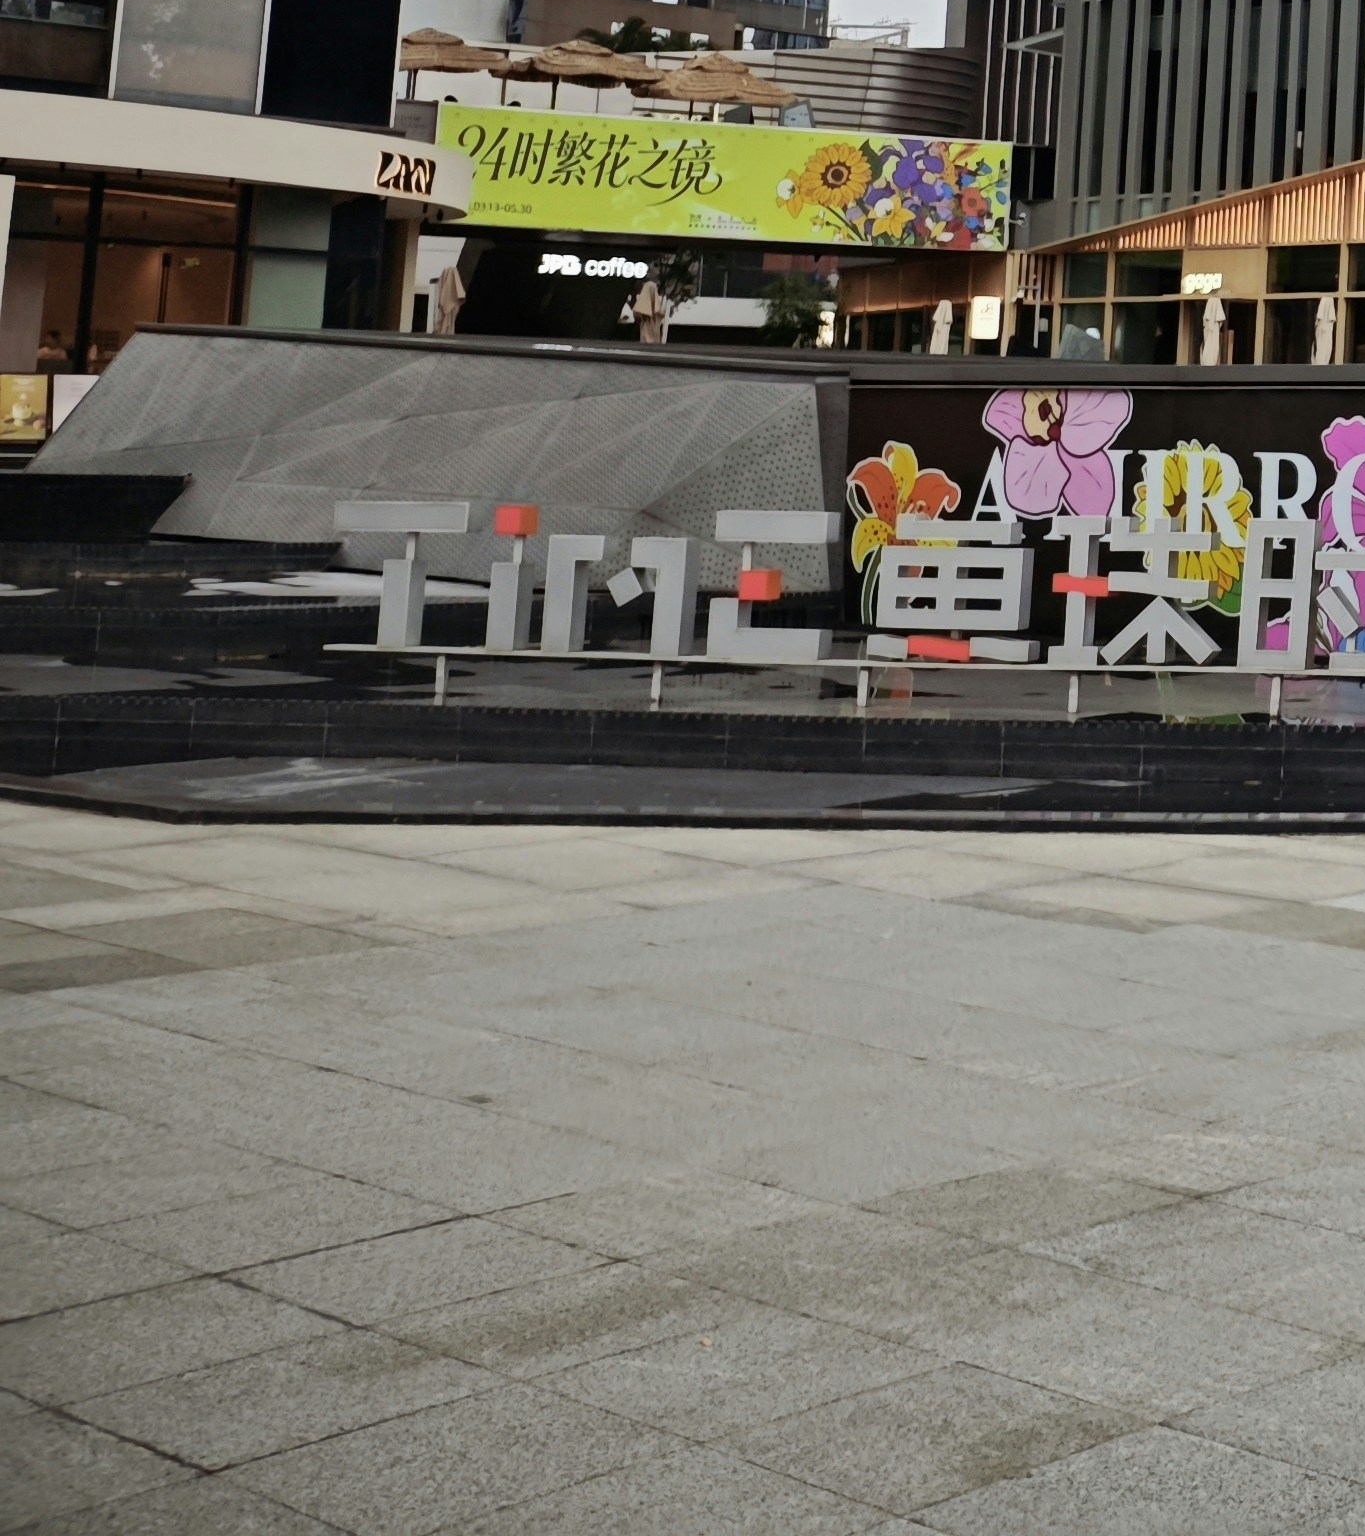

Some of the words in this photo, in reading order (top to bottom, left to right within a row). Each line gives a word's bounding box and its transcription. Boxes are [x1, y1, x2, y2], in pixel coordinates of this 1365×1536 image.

[585, 257, 648, 279] coffee
[1183, 273, 1223, 295] gaga
[970, 446, 1026, 540] A
